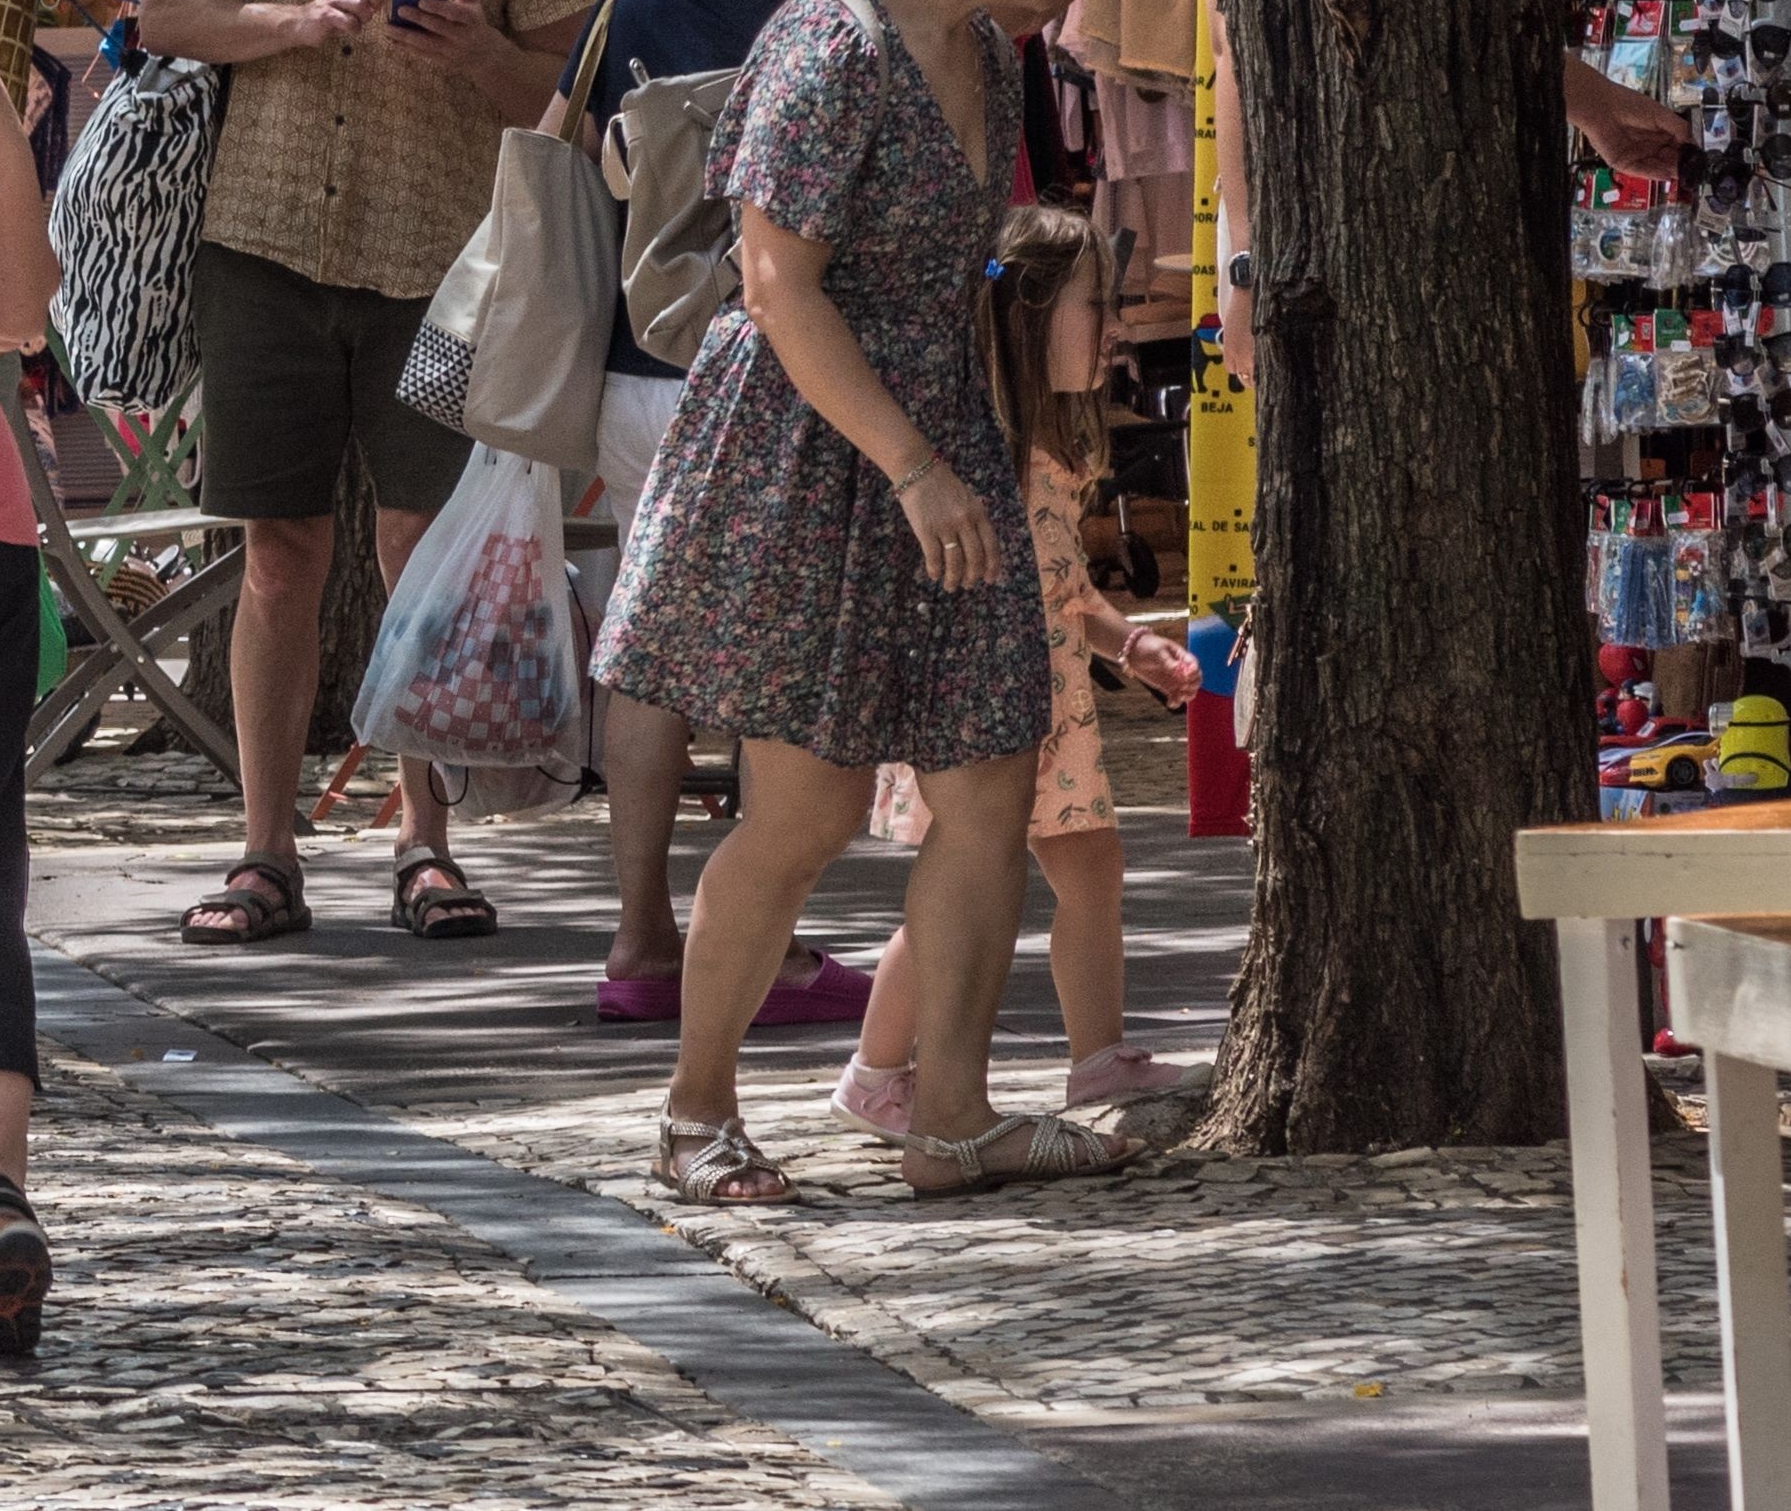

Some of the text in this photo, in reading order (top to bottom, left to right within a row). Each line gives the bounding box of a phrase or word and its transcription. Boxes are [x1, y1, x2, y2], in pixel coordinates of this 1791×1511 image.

[1200, 401, 1234, 413] BEJA
[1212, 520, 1228, 532] DE
[1213, 577, 1257, 588] TAVIRA
